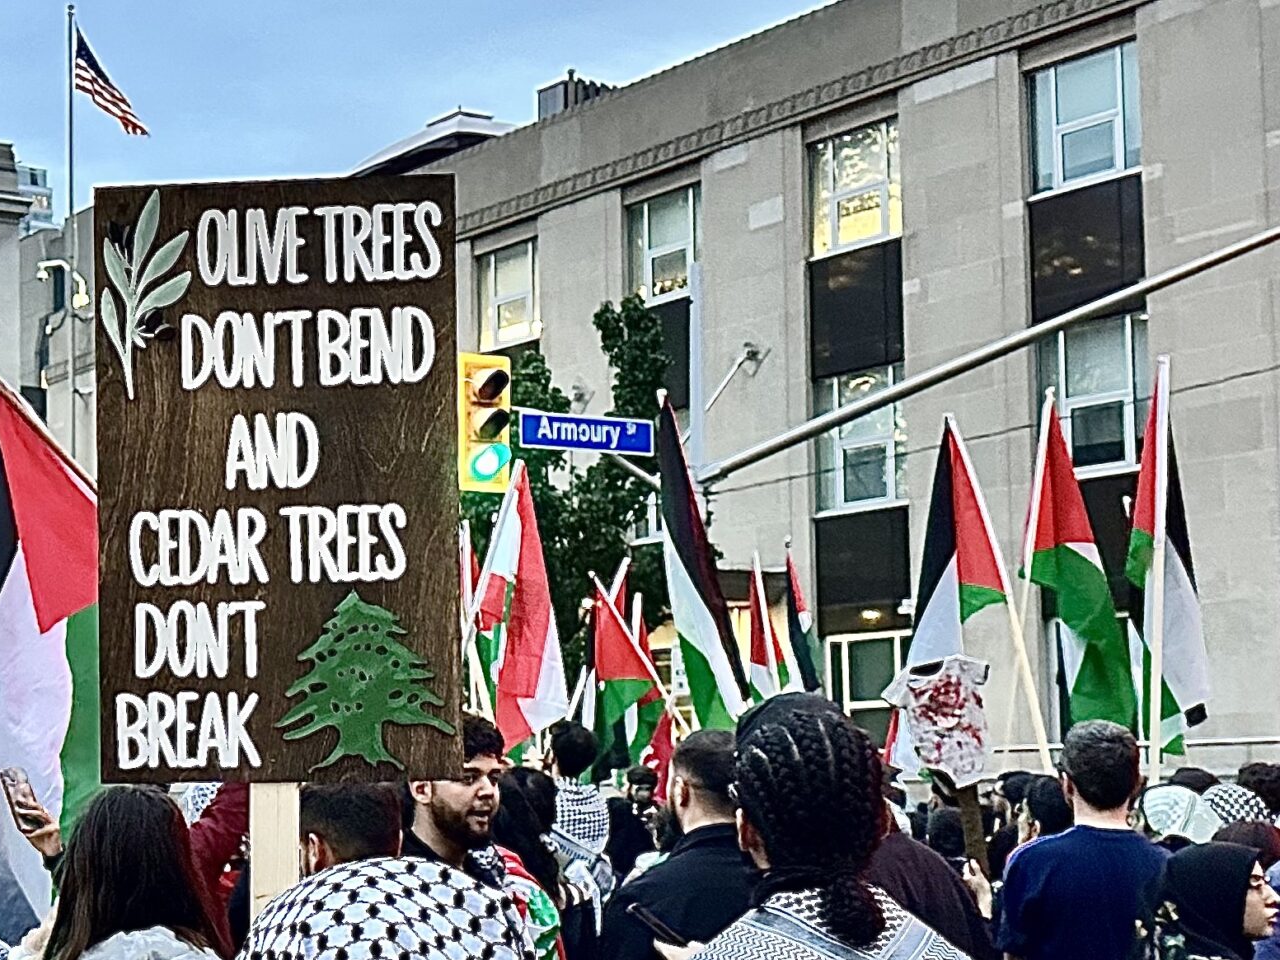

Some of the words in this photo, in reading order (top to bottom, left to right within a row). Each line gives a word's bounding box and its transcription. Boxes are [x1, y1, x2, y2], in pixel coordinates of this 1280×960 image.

[195, 205, 308, 286] OLIVE
[314, 201, 442, 283] TREES
[316, 306, 436, 387] BEND
[225, 411, 320, 492] AND
[538, 416, 621, 449] Armoury
[129, 505, 270, 588] CEDAR
[280, 503, 408, 585] TREES
[115, 690, 263, 770] BREAK
